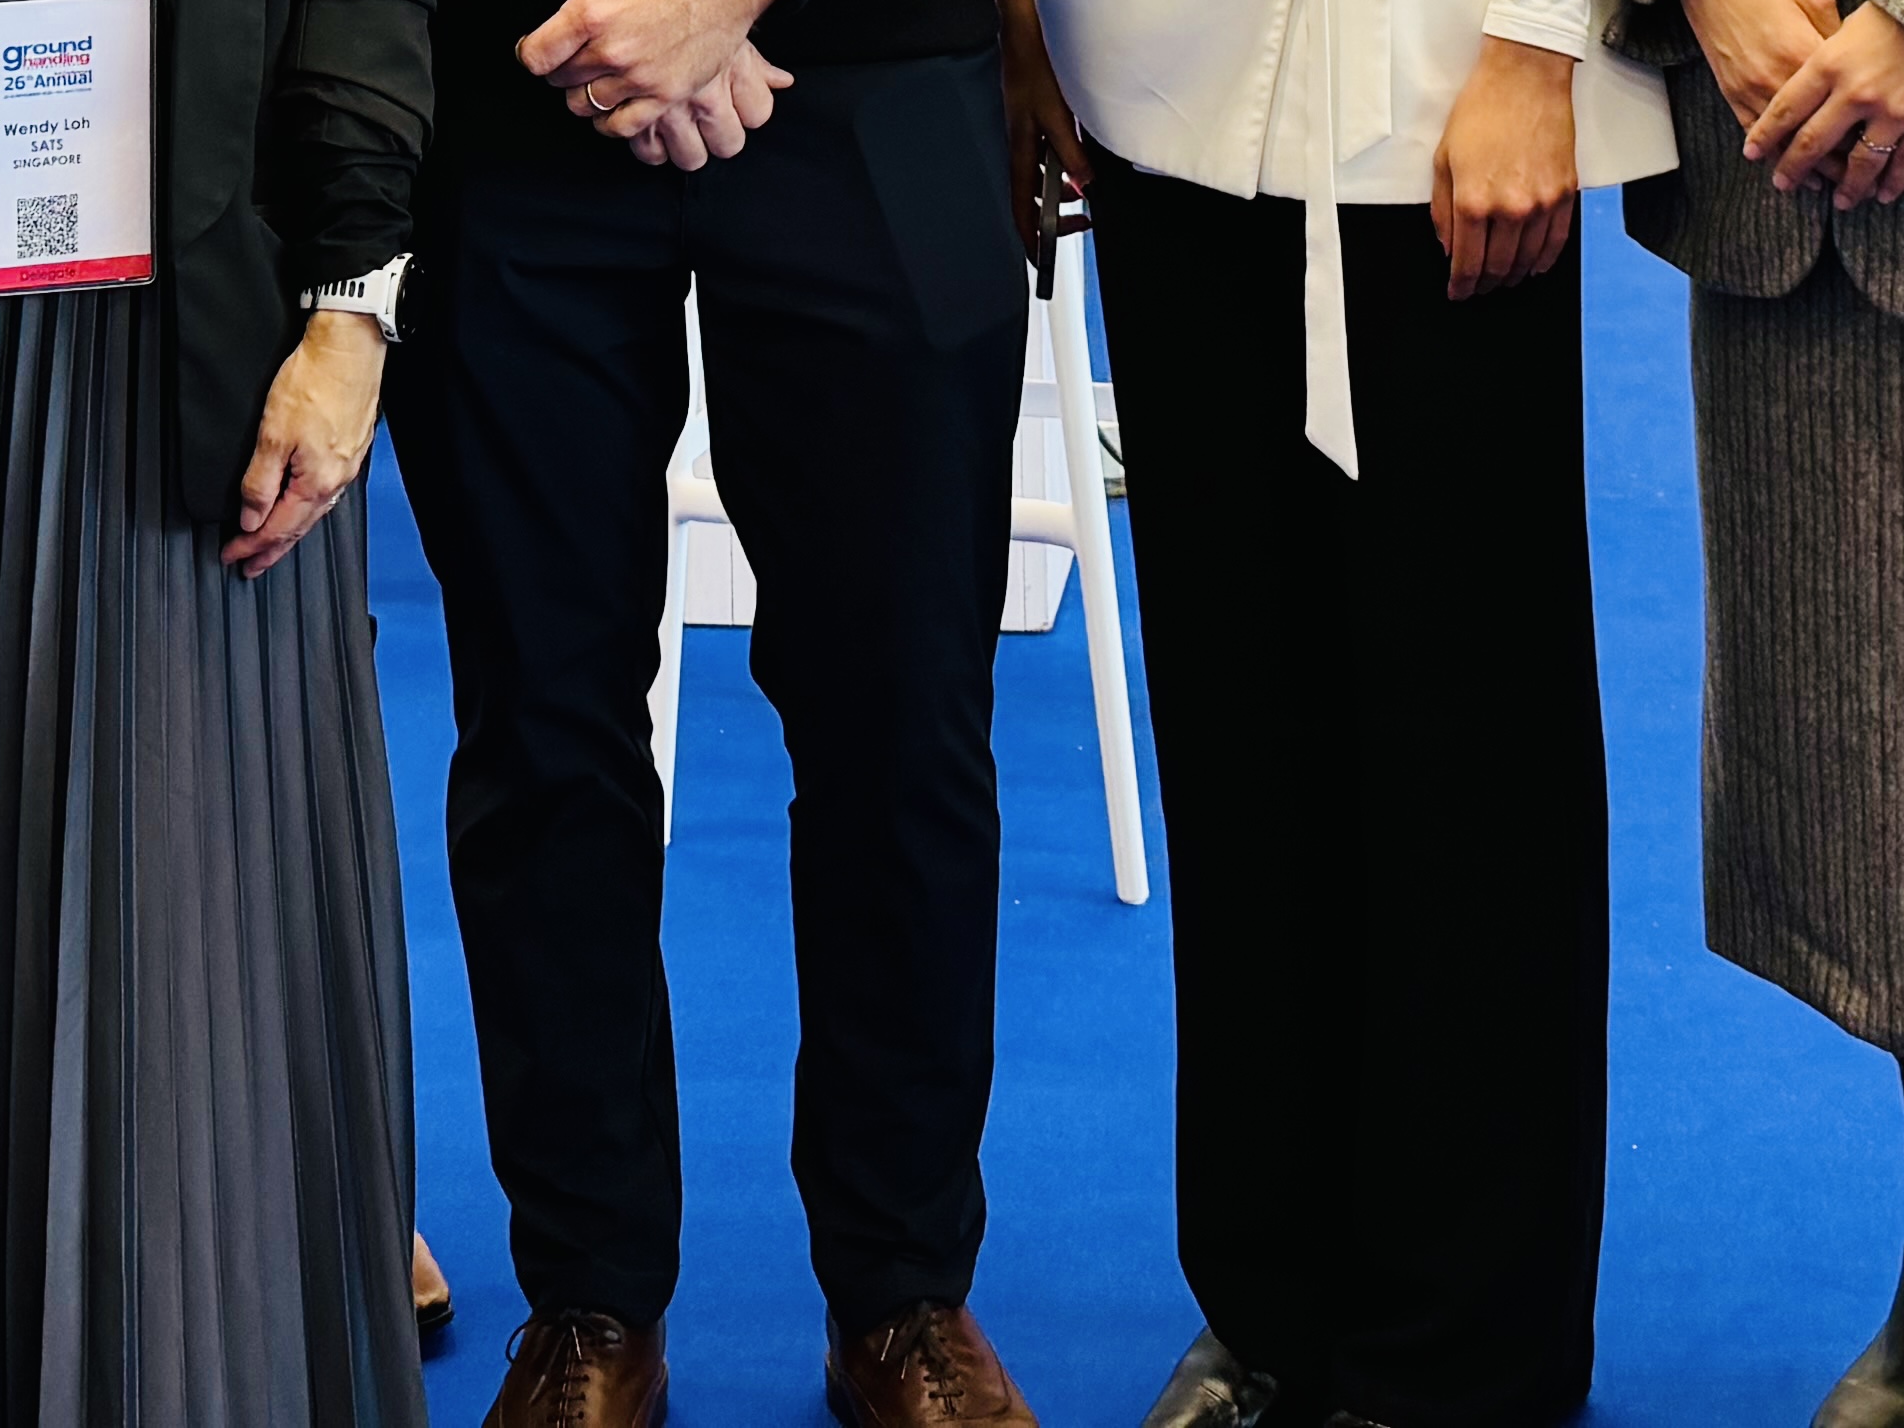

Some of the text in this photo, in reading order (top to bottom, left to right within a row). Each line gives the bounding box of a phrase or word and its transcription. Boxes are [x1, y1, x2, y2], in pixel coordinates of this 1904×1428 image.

[2, 35, 93, 72] ground
[22, 53, 90, 67] handling
[34, 69, 93, 89] Annual
[3, 117, 91, 137] Wendy Loh
[31, 138, 64, 152] SATS
[12, 154, 82, 170] SINGAPORE
